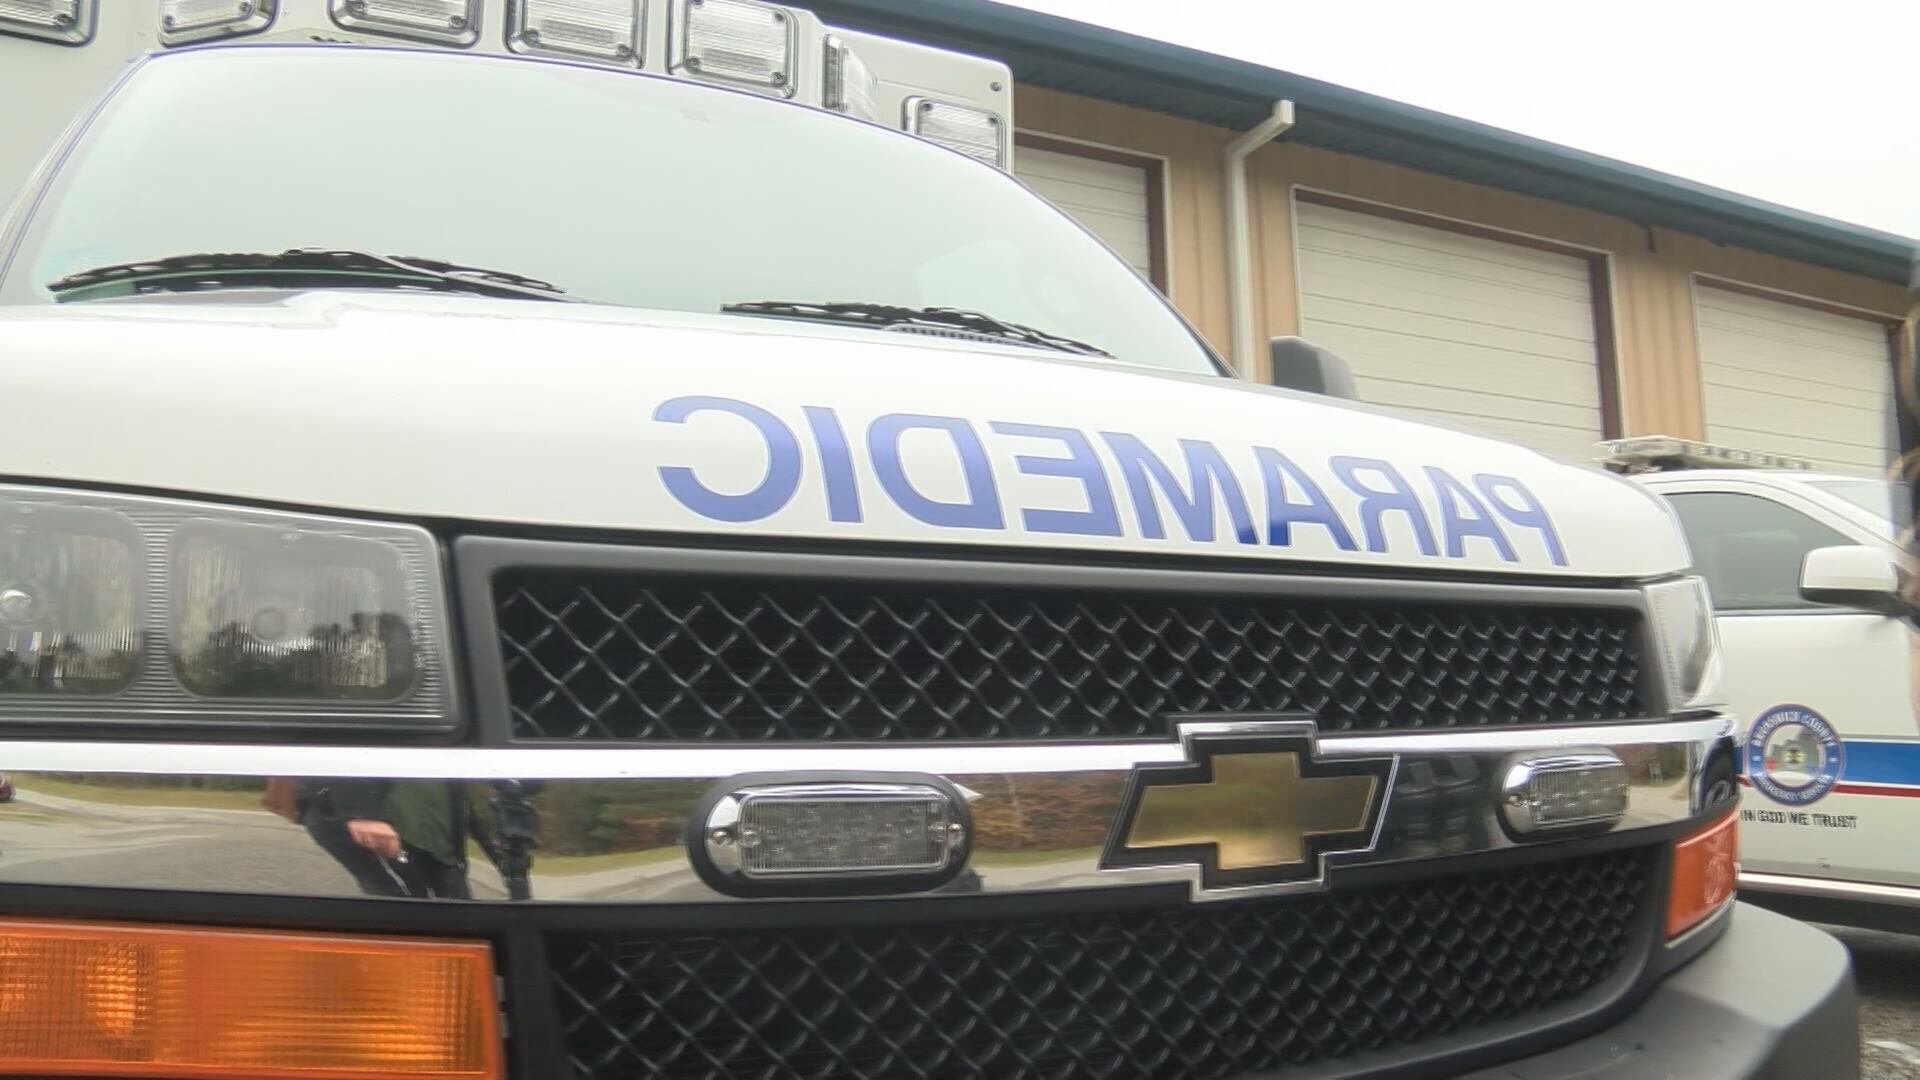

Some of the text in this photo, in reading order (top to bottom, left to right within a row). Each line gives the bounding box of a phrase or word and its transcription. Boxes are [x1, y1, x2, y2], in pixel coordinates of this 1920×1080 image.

[1741, 809, 1858, 829] IN GOD WE TRUST
